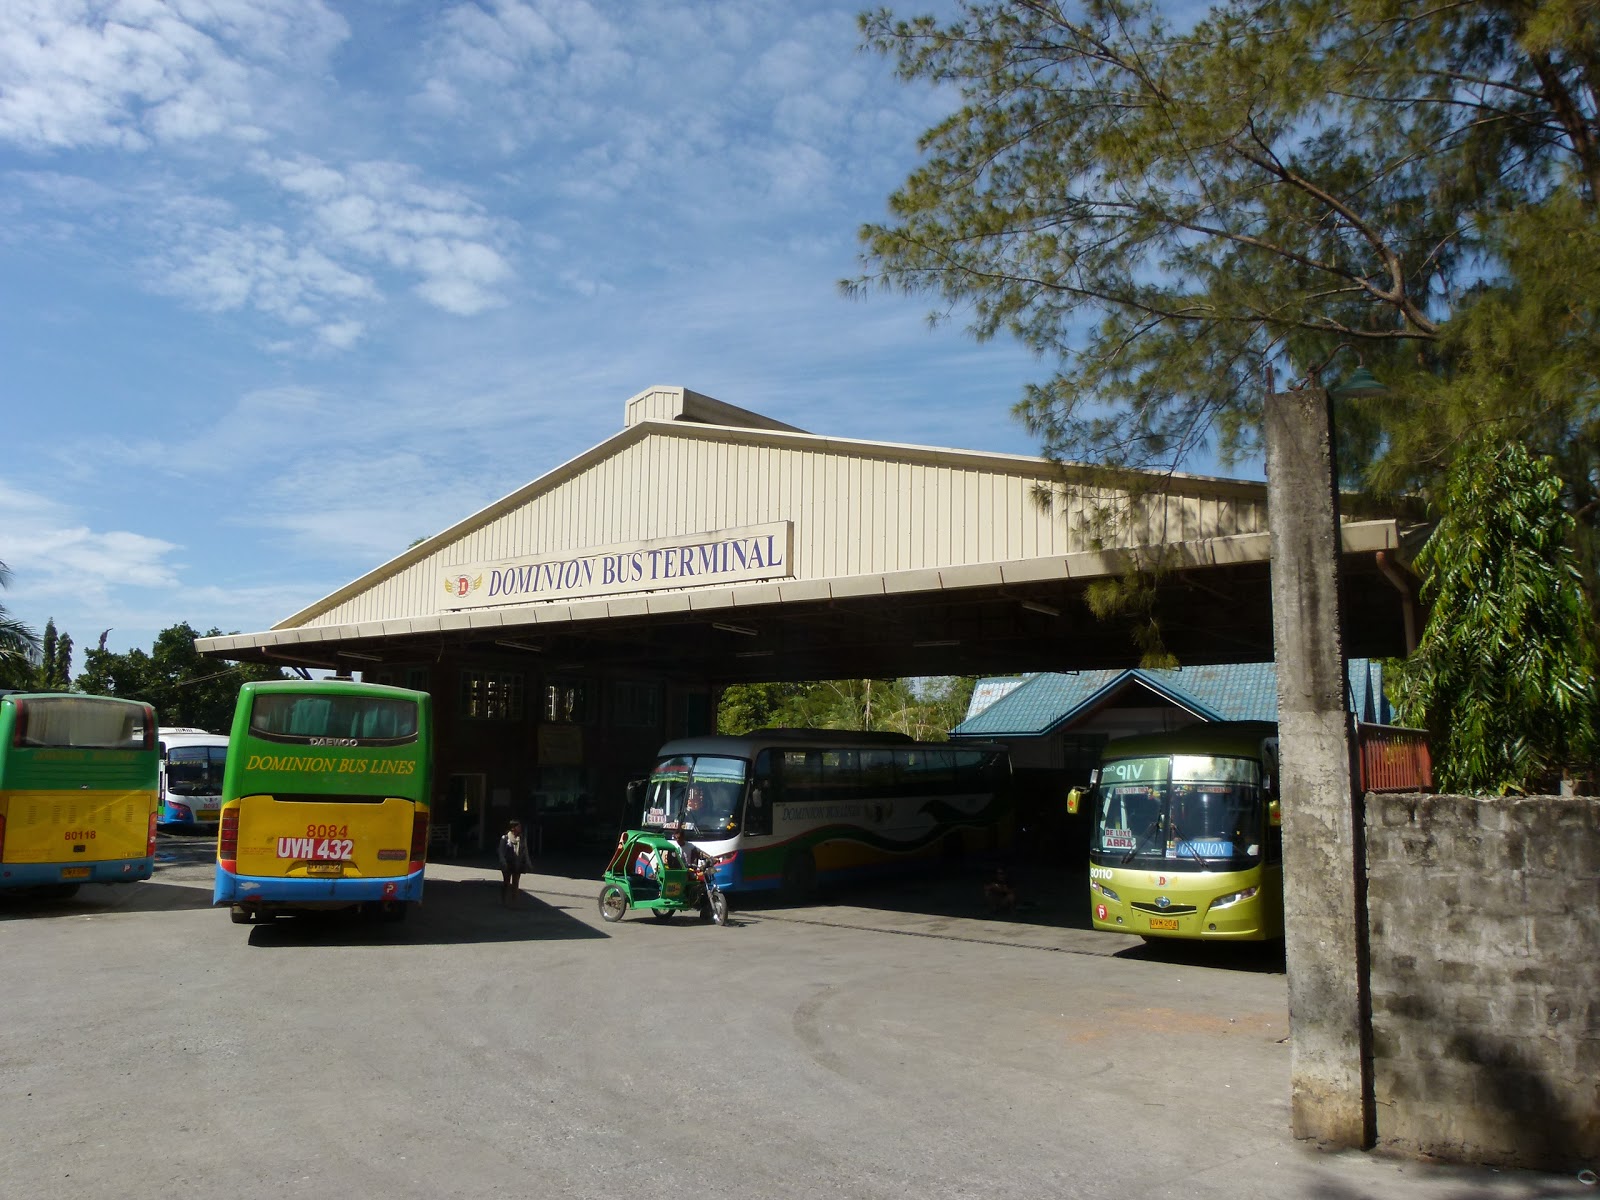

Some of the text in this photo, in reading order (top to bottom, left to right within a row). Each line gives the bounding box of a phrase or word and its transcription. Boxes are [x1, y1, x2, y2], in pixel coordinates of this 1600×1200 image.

[488, 535, 783, 597] DOMINION BUS TERMINAL
[309, 737, 358, 747] DAEWOO
[246, 755, 416, 775] DOMINION BUS LINES
[64, 831, 97, 841] 80118
[306, 824, 349, 838] 8084
[277, 838, 354, 860] UVH 432
[1106, 838, 1133, 848] ABRA
